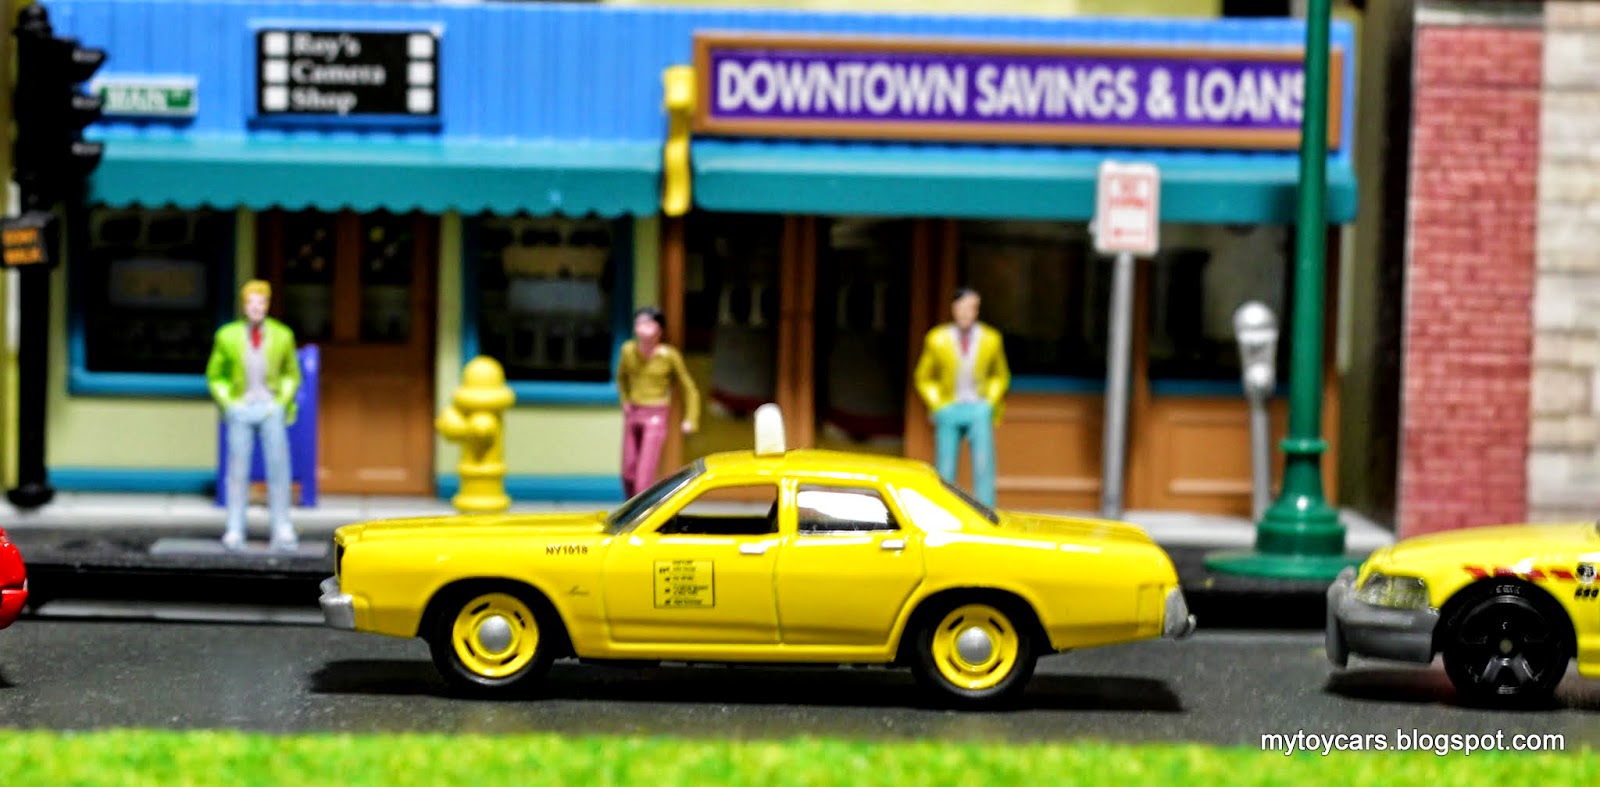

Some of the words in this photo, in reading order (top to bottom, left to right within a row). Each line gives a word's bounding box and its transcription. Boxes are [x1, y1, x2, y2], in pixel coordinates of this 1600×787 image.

[291, 58, 387, 86] Camera
[291, 86, 358, 117] Shop
[717, 59, 967, 115] DOWNTOWN
[974, 63, 1138, 119] SAVINGS
[1145, 67, 1176, 119] &
